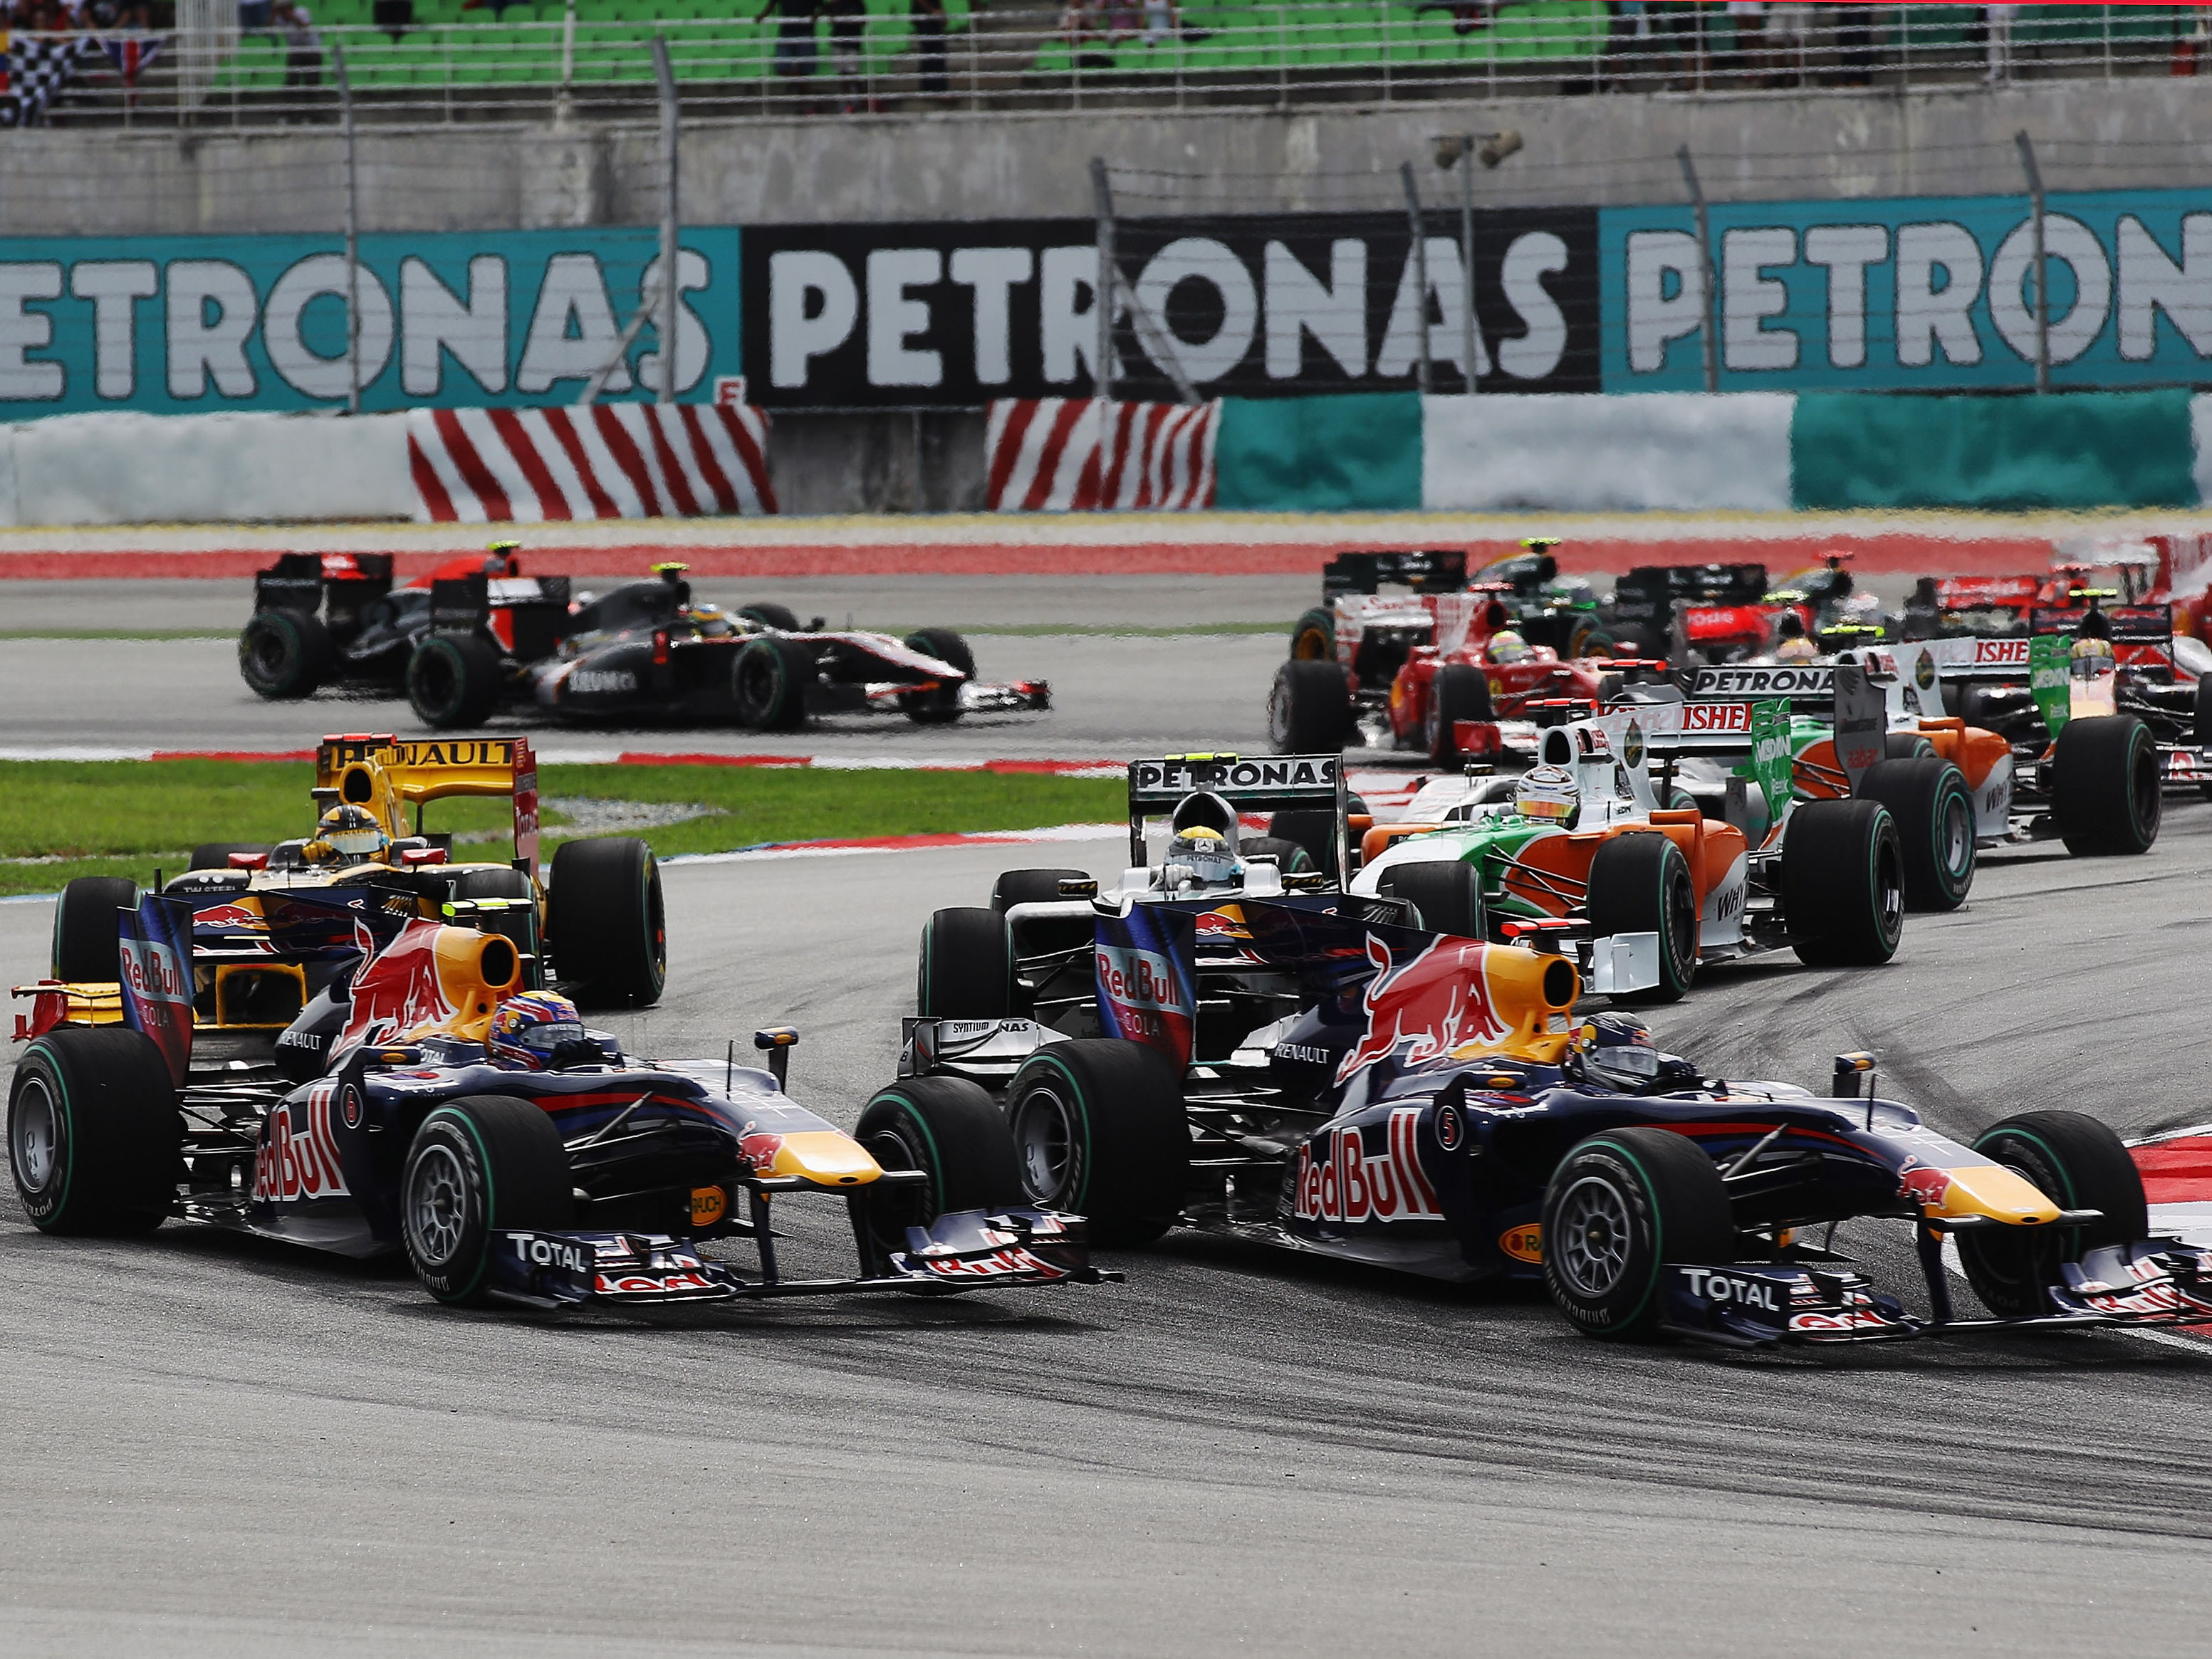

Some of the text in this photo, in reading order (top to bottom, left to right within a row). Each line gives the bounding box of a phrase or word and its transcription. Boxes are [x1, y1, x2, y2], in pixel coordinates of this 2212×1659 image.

[769, 231, 1567, 388] PETRONAS
[337, 743, 512, 768] RNAULT
[1139, 760, 1335, 789] PETRONAS
[152, 951, 183, 997] Bull
[1097, 953, 1181, 1007] Red Bull
[1124, 1012, 1161, 1037] COLA
[1273, 1042, 1330, 1064] RENAULT
[277, 1084, 351, 1202] Bull
[1444, 1113, 1455, 1145] 5
[1295, 1107, 1446, 1223] Red Bull
[506, 1233, 587, 1273] TOTAL
[1679, 1268, 1780, 1312] TOTAL
